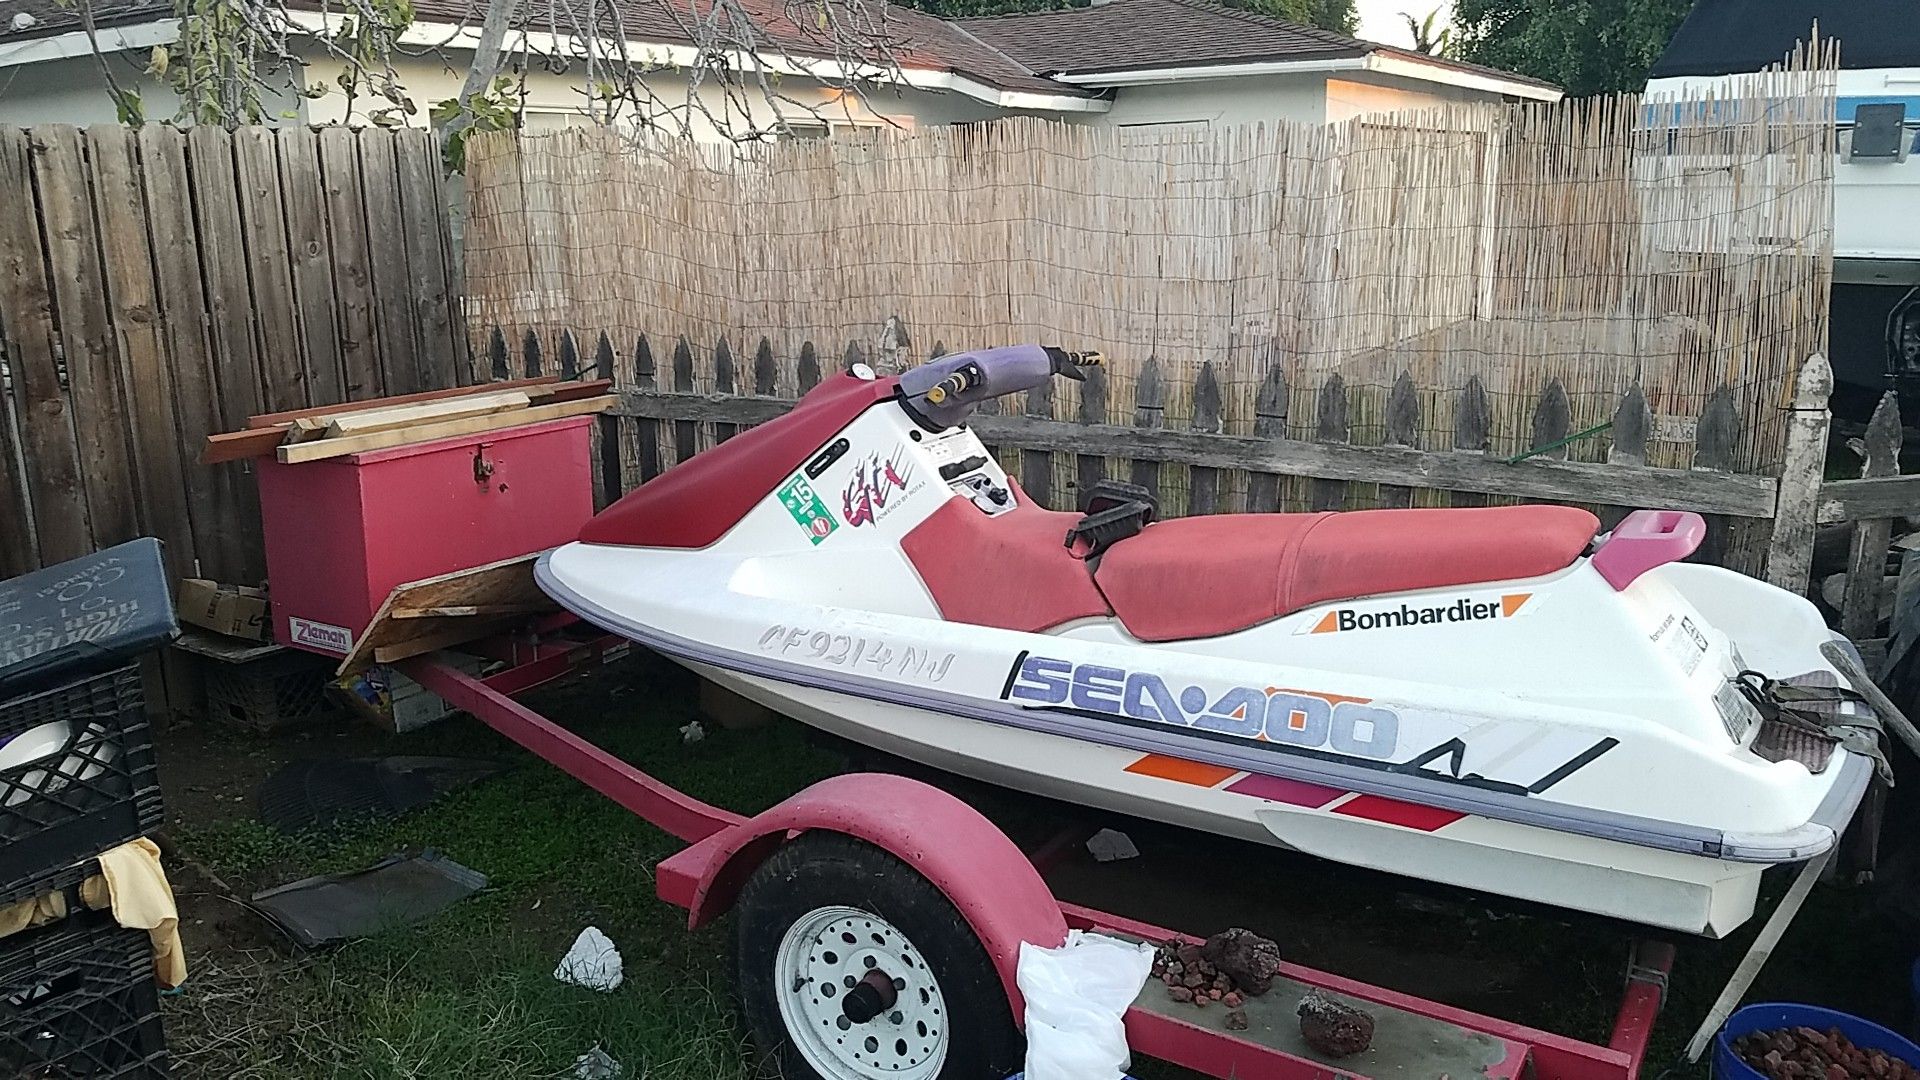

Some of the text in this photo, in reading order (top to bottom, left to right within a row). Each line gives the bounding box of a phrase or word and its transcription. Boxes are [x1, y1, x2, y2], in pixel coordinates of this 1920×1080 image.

[790, 479, 814, 505] 15
[876, 499, 902, 521] POWERED
[908, 480, 927, 497] ROTAX
[64, 600, 139, 632] HIGH
[1338, 598, 1501, 632] Bombardier
